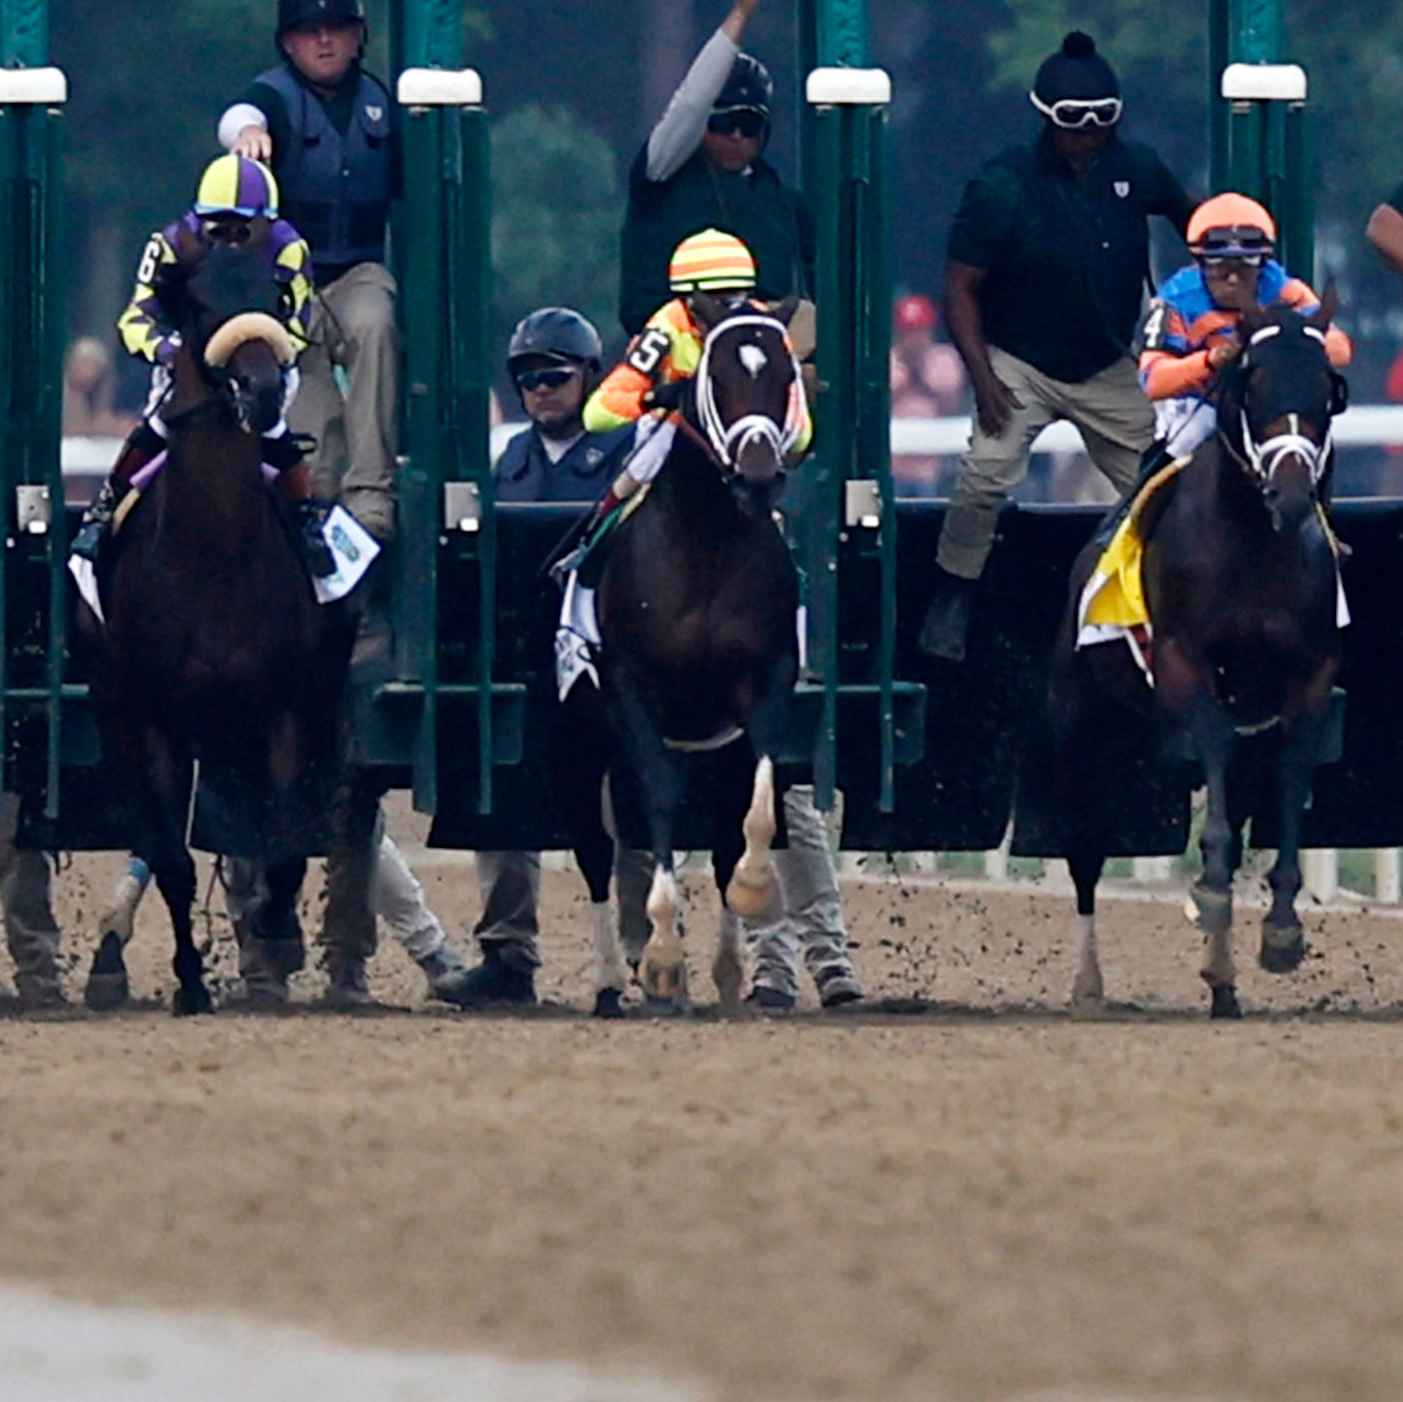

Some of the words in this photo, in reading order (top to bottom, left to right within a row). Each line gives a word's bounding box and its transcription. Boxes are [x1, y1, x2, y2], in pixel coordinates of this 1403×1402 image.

[137, 240, 160, 284] 6
[1143, 307, 1164, 348] 4
[630, 330, 669, 373] 5
